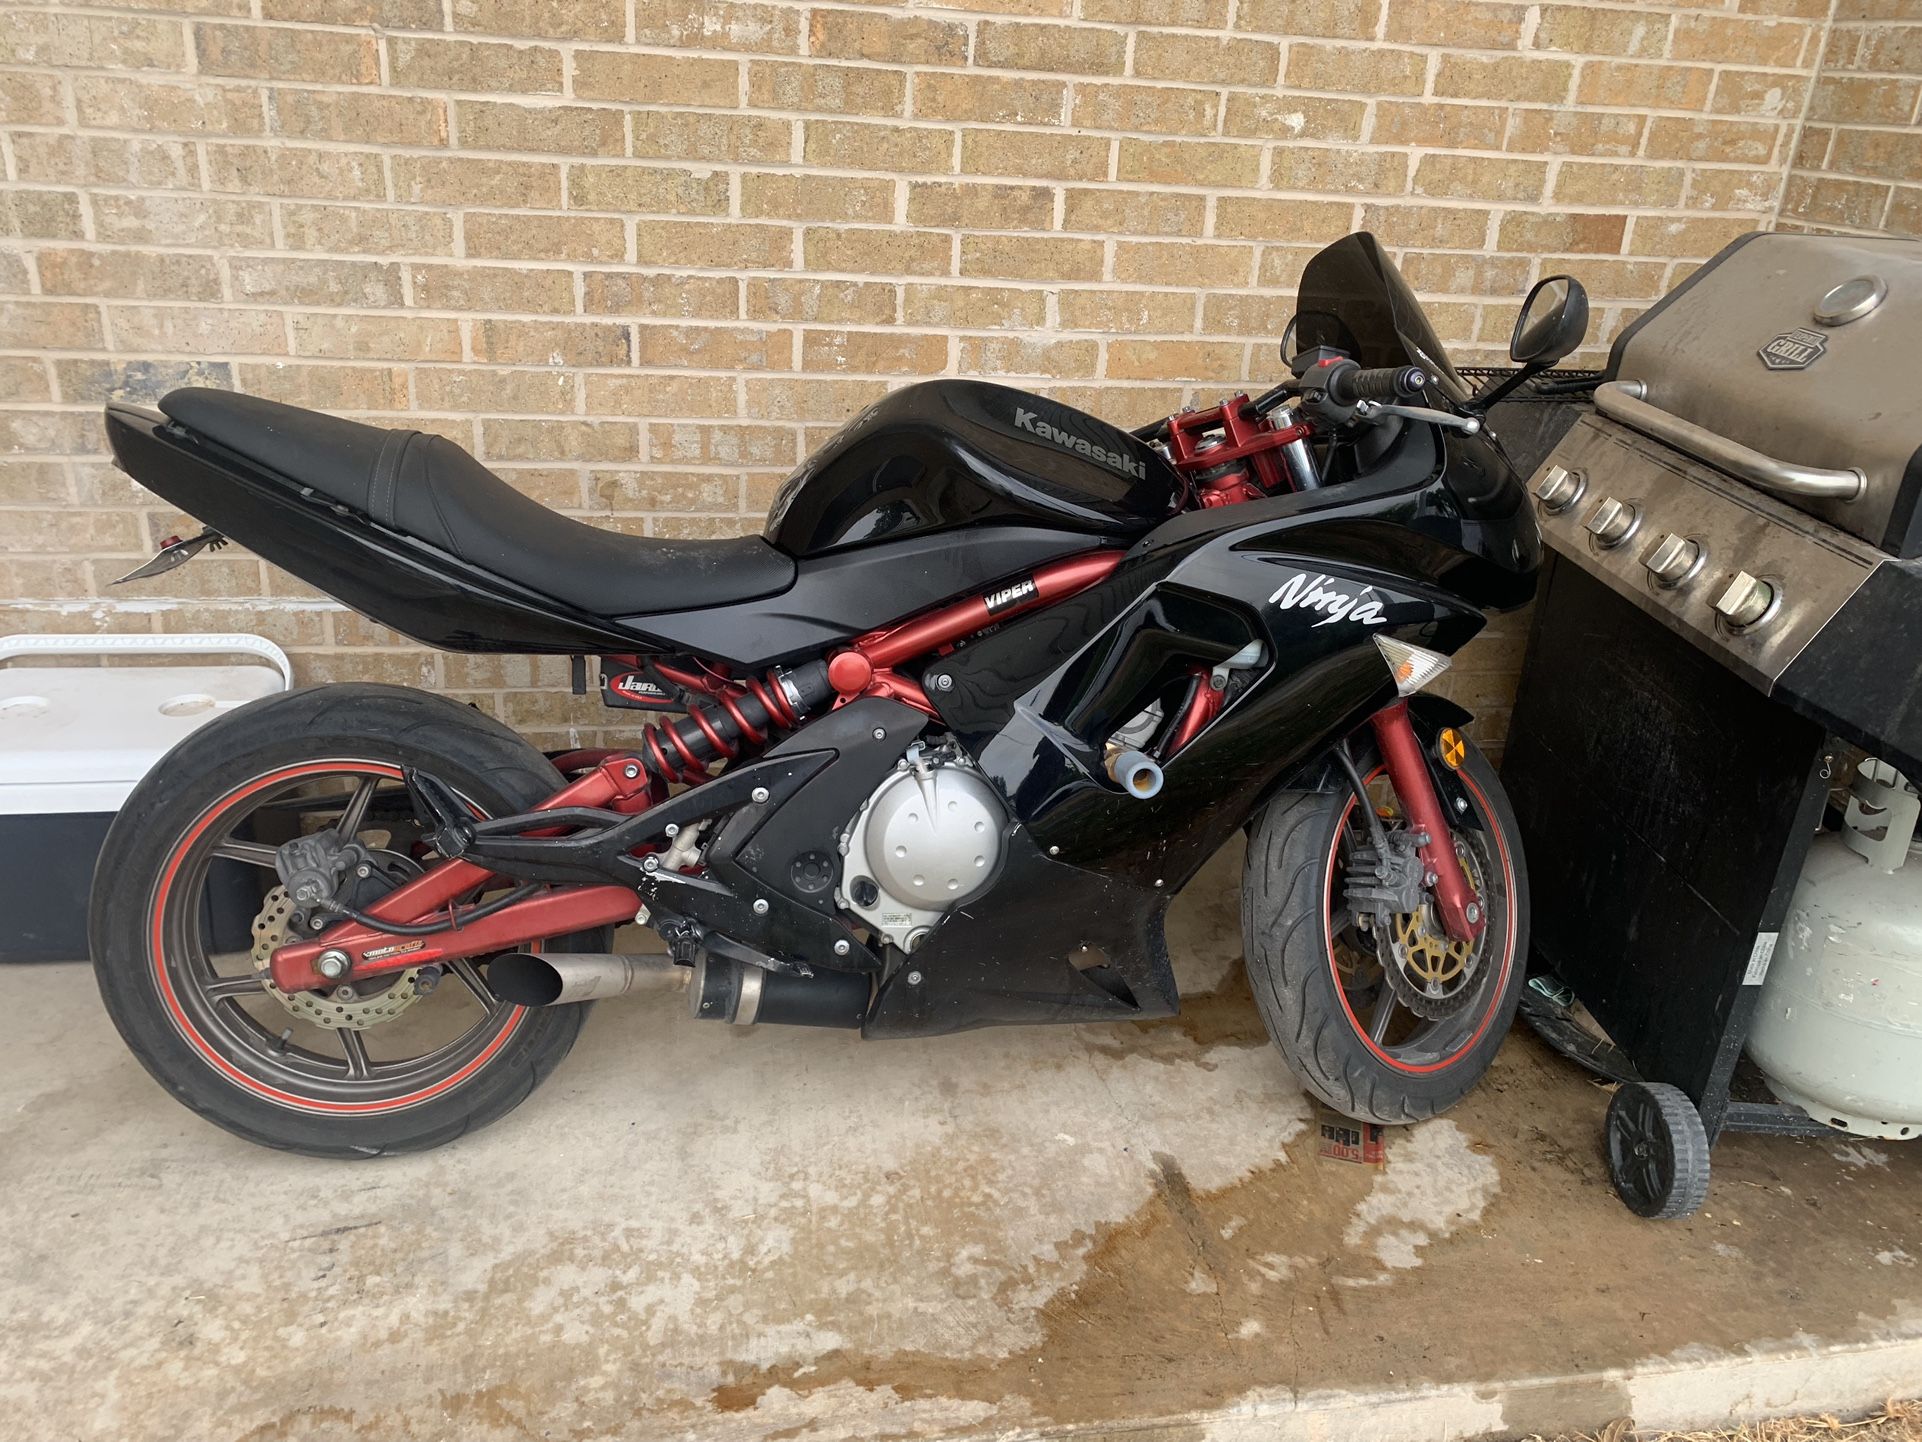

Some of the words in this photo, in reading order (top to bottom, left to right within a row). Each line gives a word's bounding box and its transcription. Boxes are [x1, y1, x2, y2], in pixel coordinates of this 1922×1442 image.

[1767, 339, 1813, 363] GRILL
[1014, 407, 1146, 480] Kawasaki
[984, 580, 1036, 608] VIPER
[1268, 573, 1387, 628] Ninja
